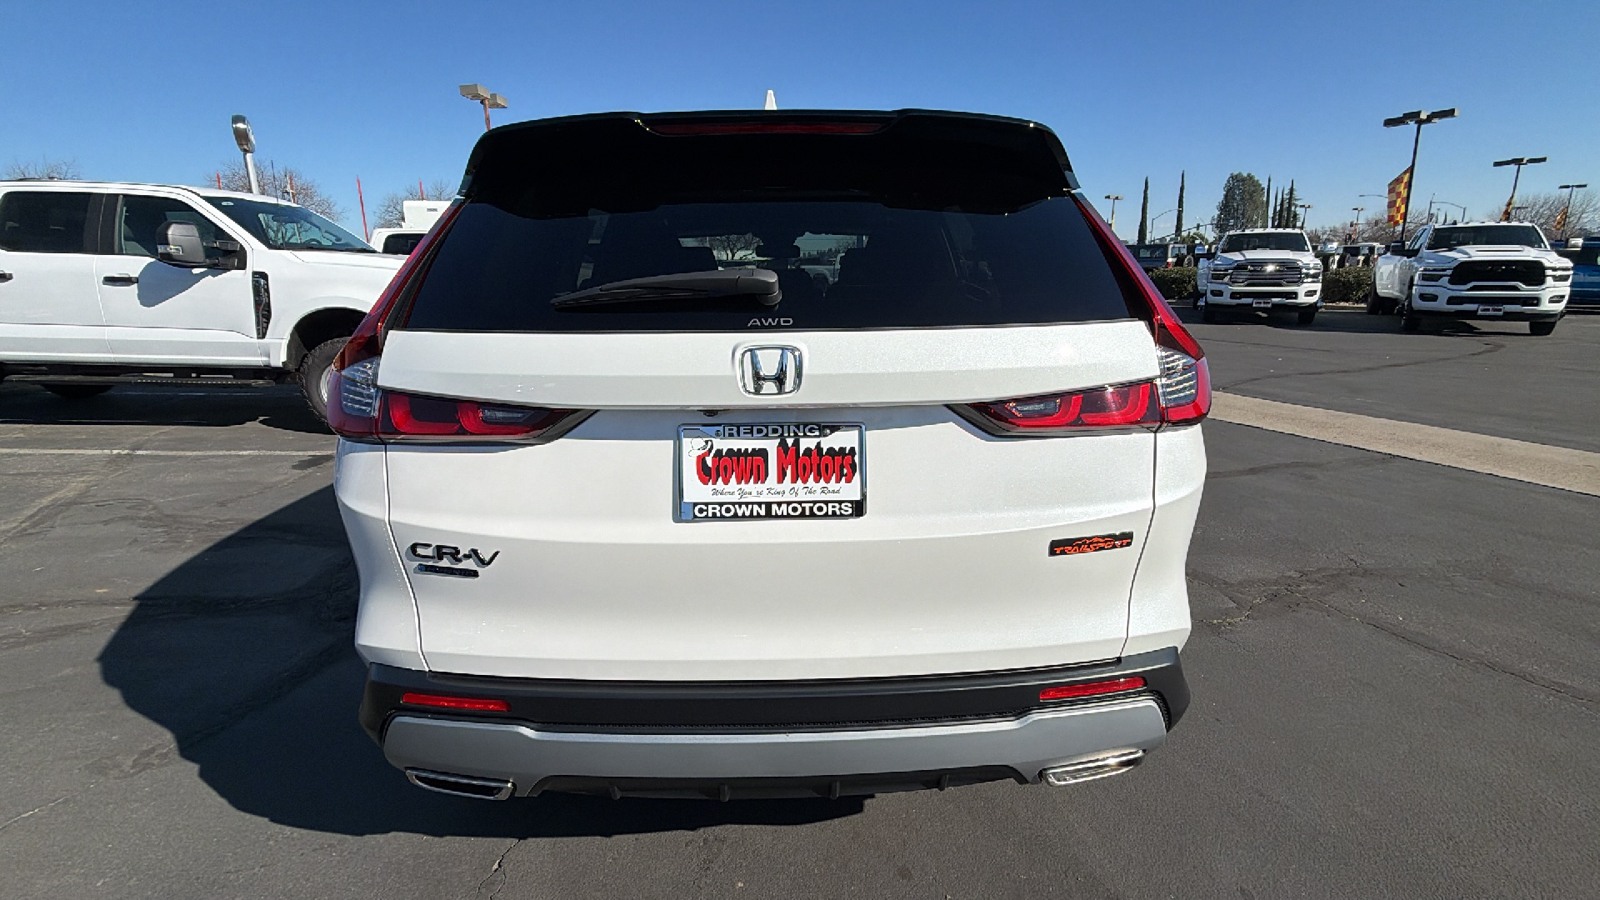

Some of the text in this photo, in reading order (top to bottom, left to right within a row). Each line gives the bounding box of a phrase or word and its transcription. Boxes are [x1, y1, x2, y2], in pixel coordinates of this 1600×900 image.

[747, 318, 793, 327] AWD
[724, 424, 820, 437] REDDING
[696, 442, 857, 486] Crown Motors
[711, 488, 735, 496] Where
[766, 487, 786, 497] King
[788, 487, 800, 497] Of
[802, 486, 817, 495] The
[819, 486, 842, 495] Road
[694, 502, 853, 518] CROWN MOTORS
[1053, 538, 1132, 554] TRAILSPORT
[406, 542, 500, 568] CR-V
